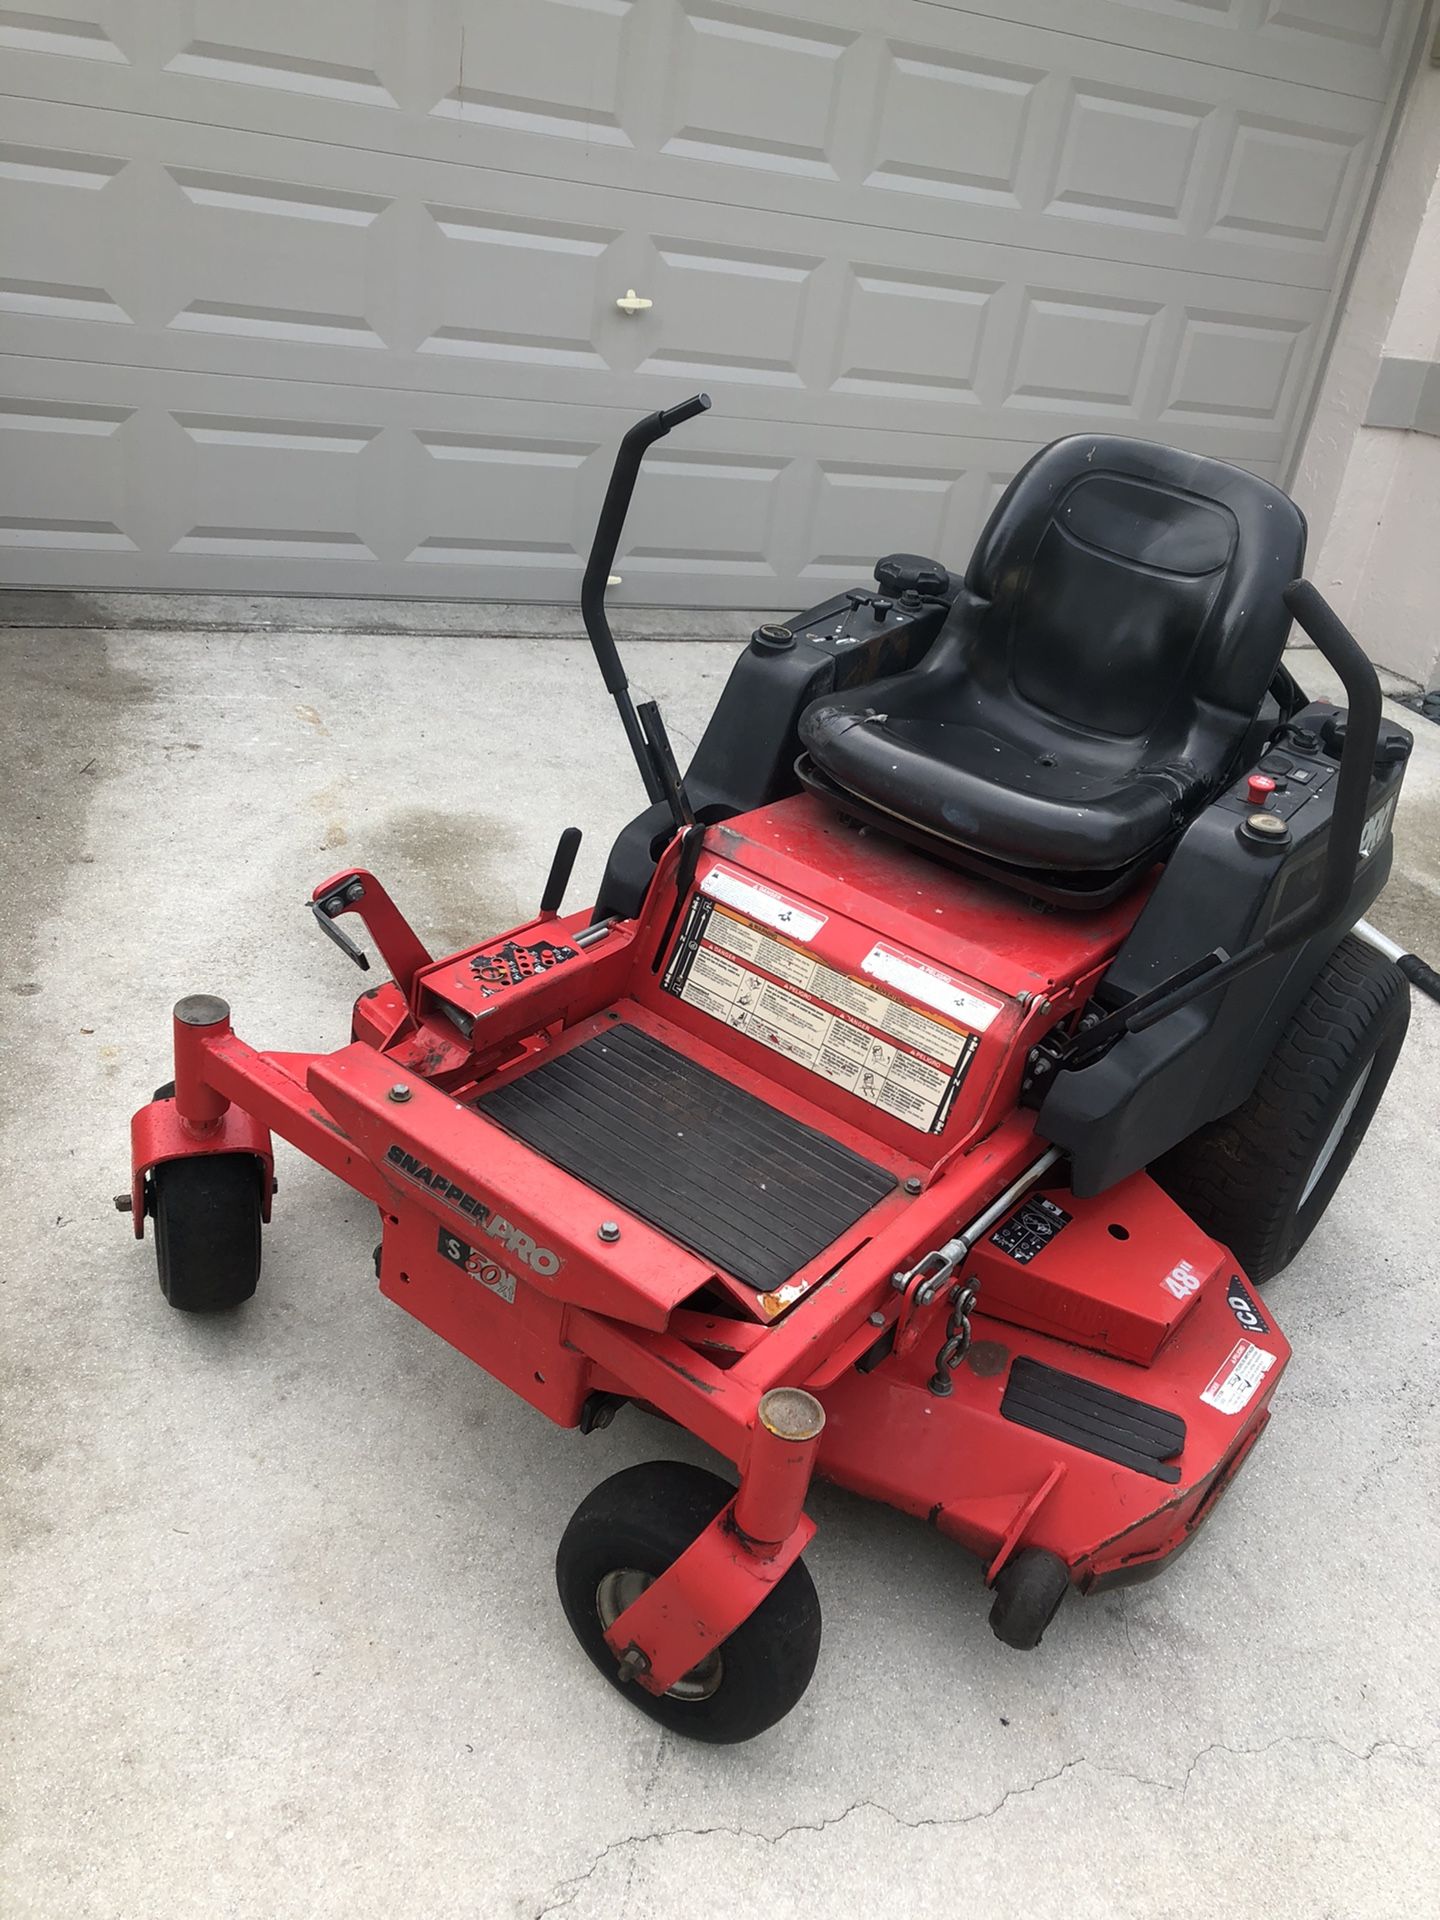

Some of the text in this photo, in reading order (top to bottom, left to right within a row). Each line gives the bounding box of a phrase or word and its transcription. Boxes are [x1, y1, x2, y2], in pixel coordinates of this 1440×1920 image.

[713, 945, 736, 962] DANGER
[914, 1050, 941, 1068] PELIGRO
[386, 1144, 561, 1276] SNAPPER PRO
